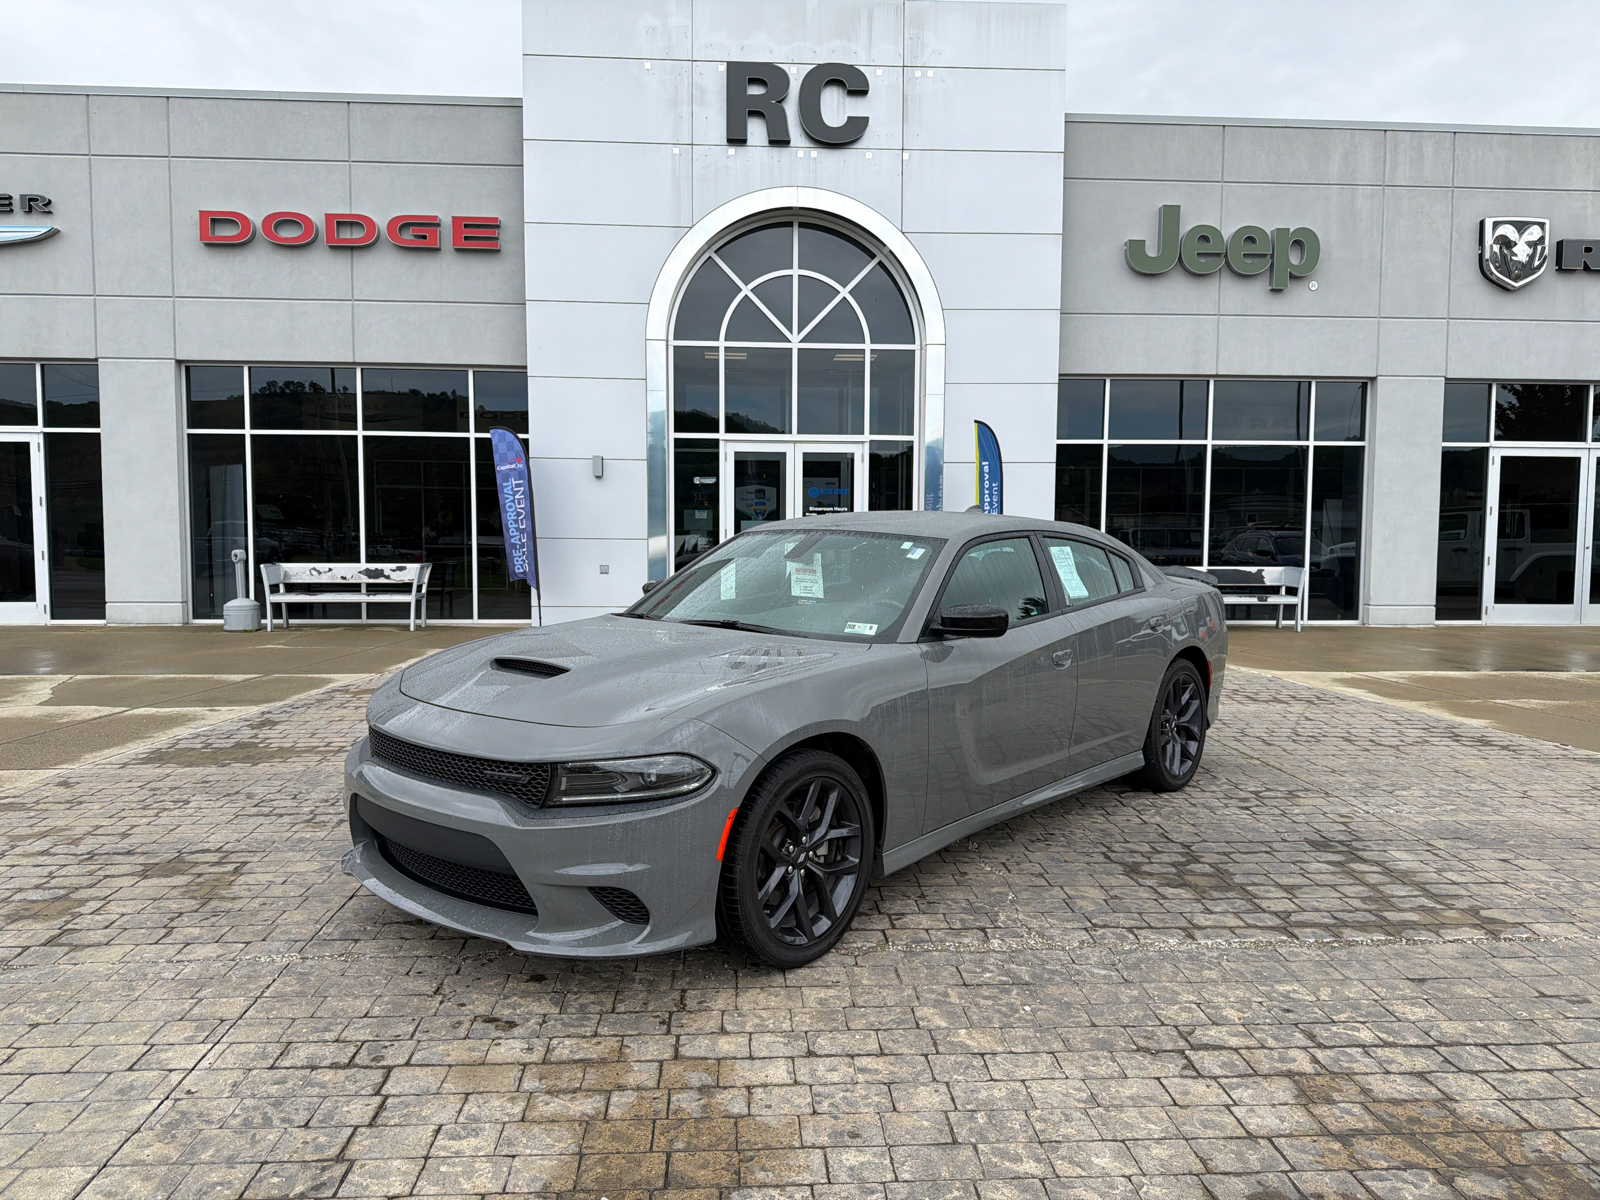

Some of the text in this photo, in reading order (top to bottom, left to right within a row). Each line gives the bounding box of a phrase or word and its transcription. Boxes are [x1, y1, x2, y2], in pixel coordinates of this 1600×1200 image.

[726, 61, 870, 146] RC
[198, 209, 502, 252] DODGE
[1124, 204, 1321, 292] Jeep
[502, 477, 525, 573] PRE-APPROVAL
[511, 477, 526, 529] EVENT
[990, 481, 999, 515] Event
